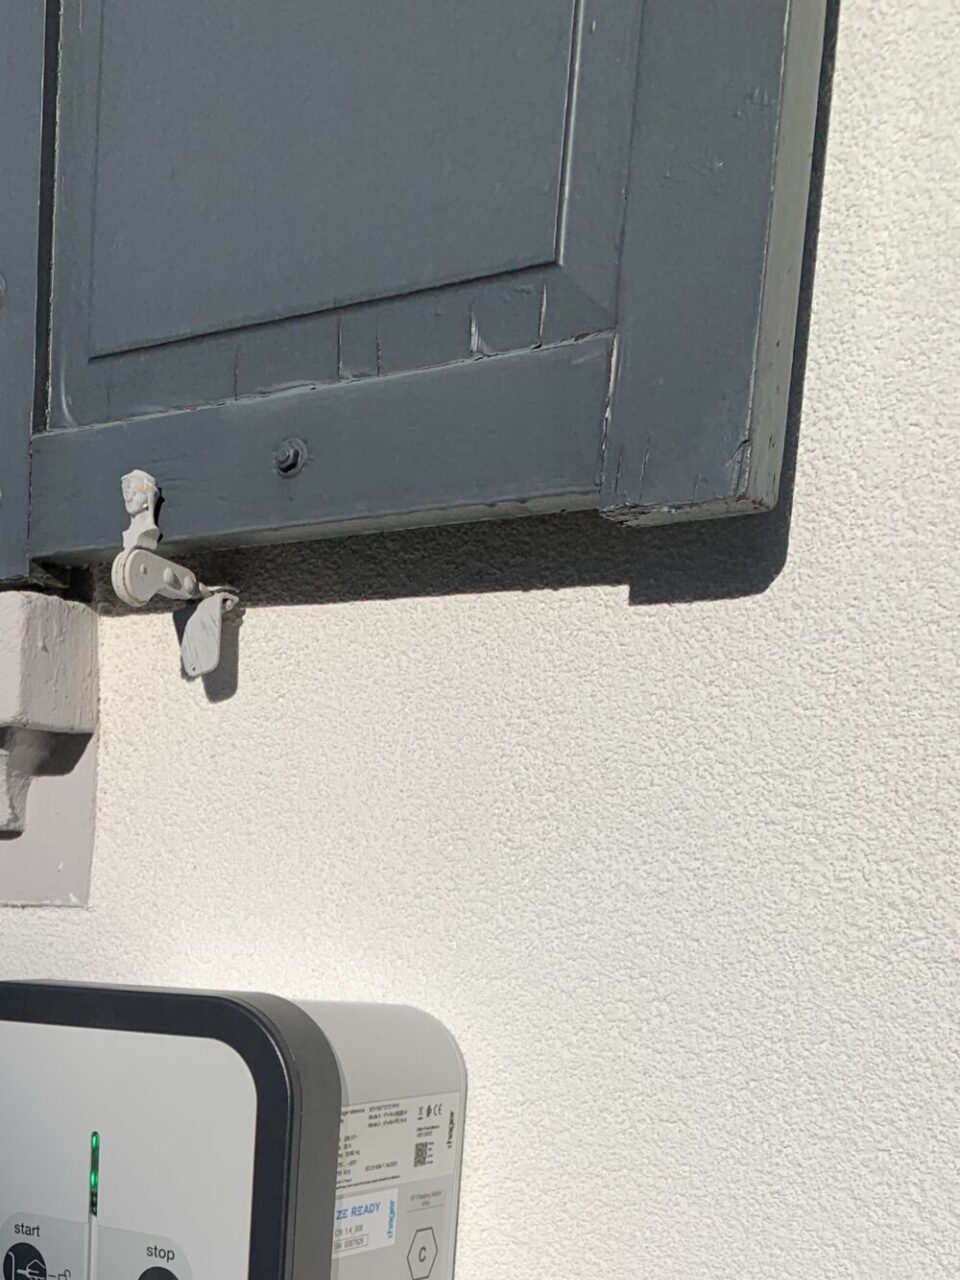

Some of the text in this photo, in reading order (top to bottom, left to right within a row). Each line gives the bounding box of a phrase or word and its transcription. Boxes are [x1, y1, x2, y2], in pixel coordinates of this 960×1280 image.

[351, 1201, 381, 1218] READY
[14, 1222, 41, 1237] start
[146, 1245, 175, 1262] stop
